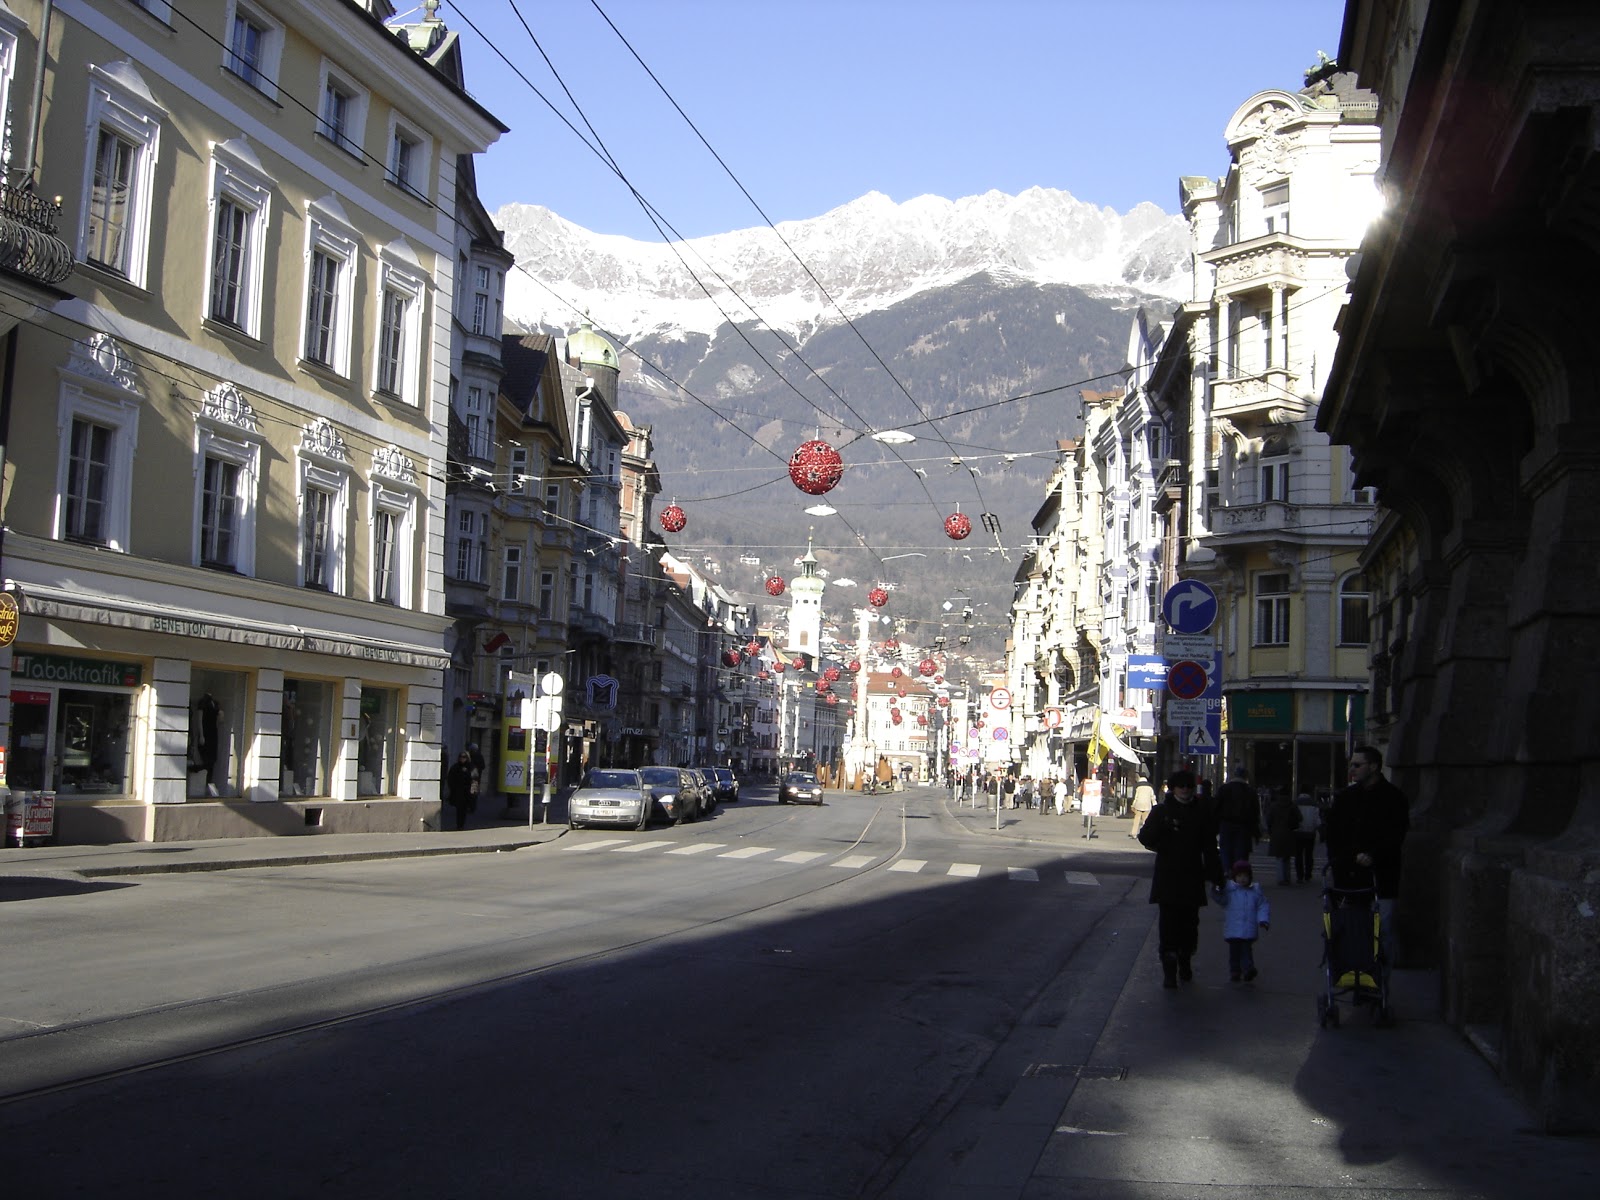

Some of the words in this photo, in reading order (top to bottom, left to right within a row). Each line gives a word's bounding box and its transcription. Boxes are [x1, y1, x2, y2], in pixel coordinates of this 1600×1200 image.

[154, 617, 206, 635] BENETTON
[362, 645, 400, 662] BENETTON
[24, 656, 121, 685] Tabaktrafik
[25, 804, 52, 819] Kronen
[24, 819, 51, 834] Zeitung
